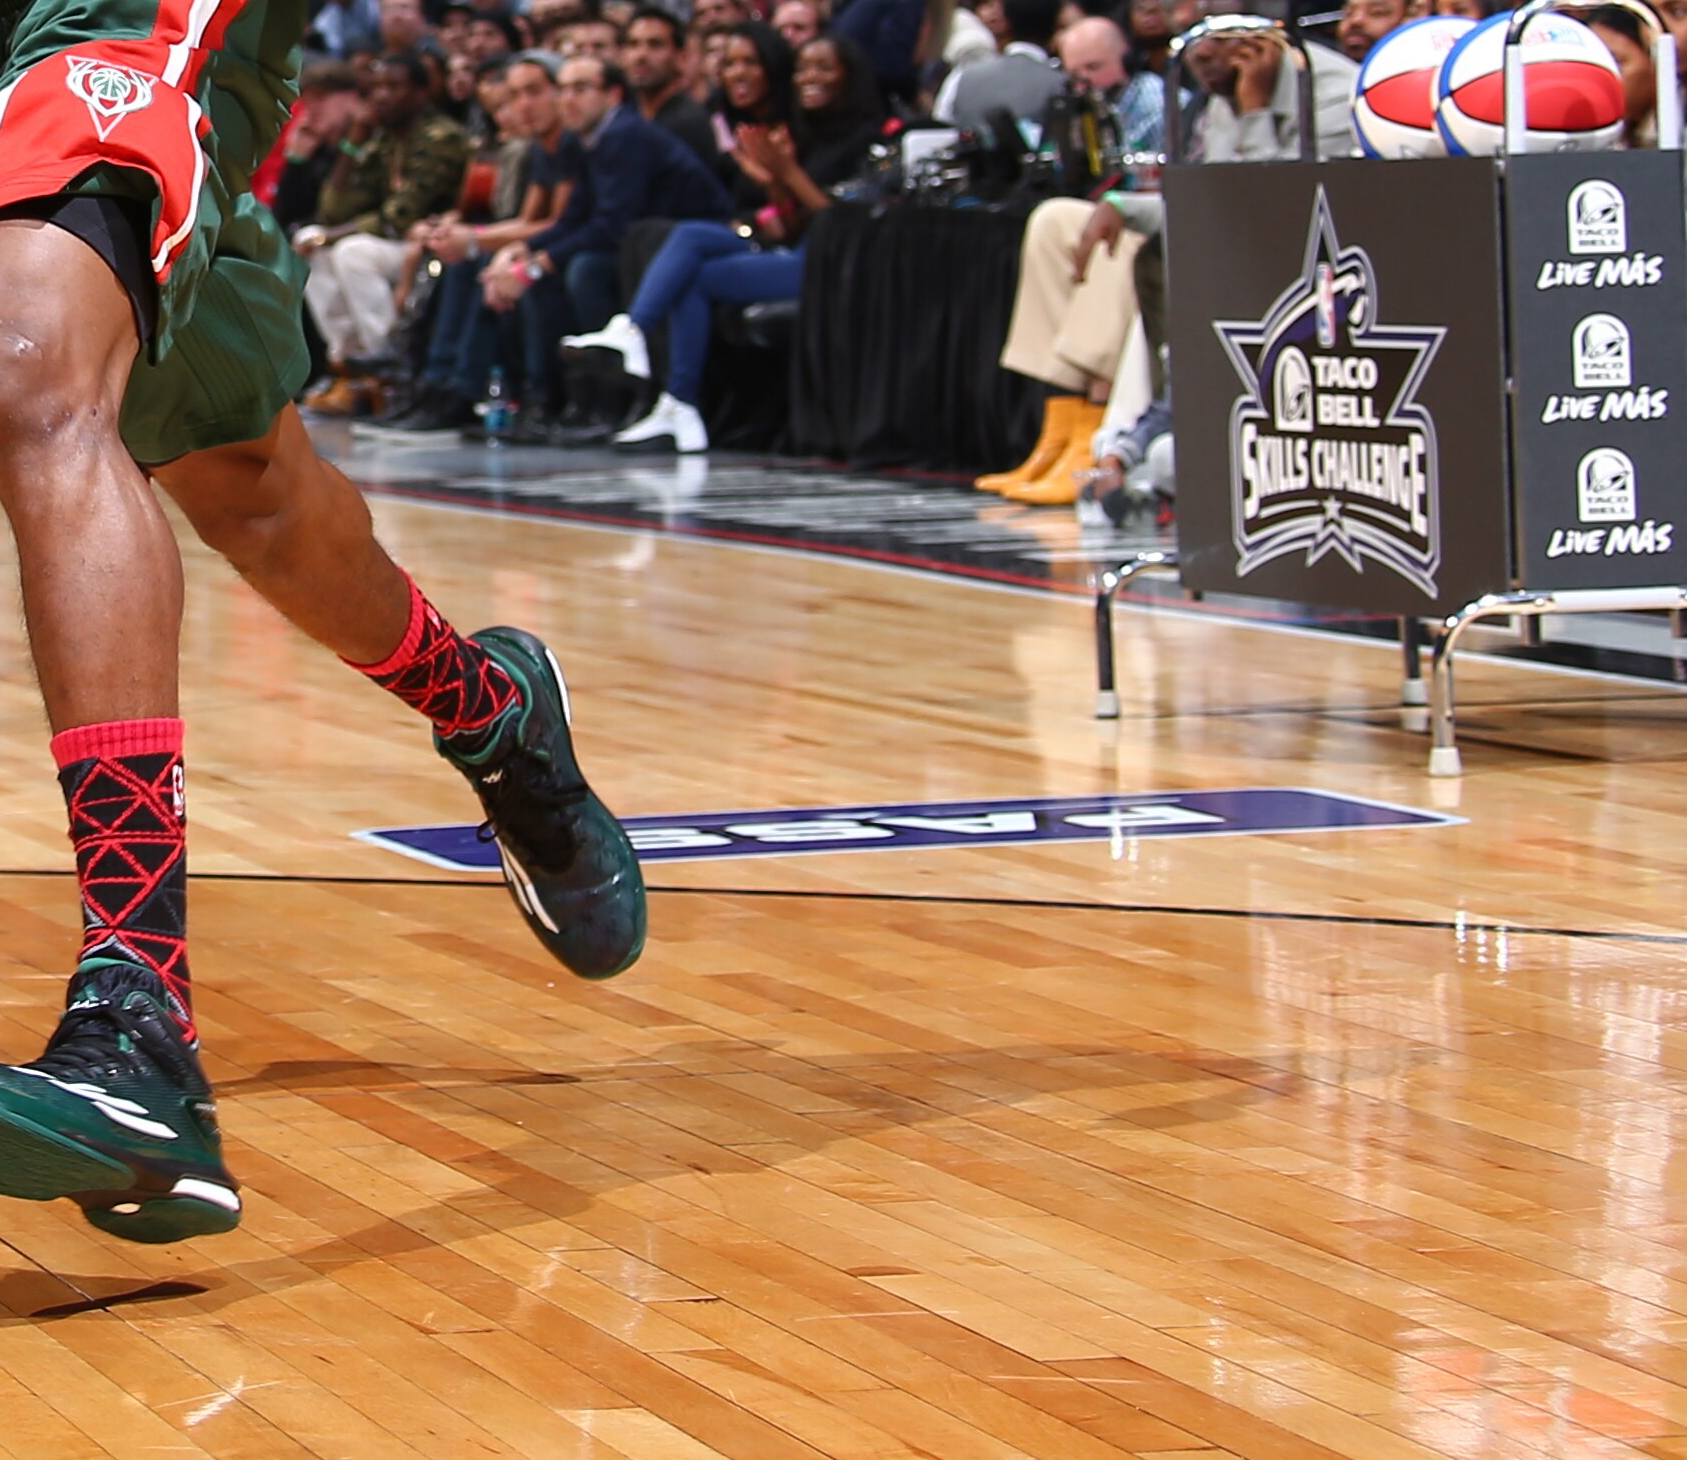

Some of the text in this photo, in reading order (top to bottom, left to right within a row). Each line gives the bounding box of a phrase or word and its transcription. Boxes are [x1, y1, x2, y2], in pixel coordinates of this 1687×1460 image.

[1594, 251, 1663, 288] MÁS
[1311, 355, 1378, 390] TACO
[1316, 393, 1381, 428] BELL
[1599, 385, 1669, 422] MÁS
[1242, 422, 1309, 519] SKILLS
[1312, 433, 1428, 537] CHALLENGE
[1604, 519, 1674, 556] MÁS
[628, 804, 1226, 851] PASS
